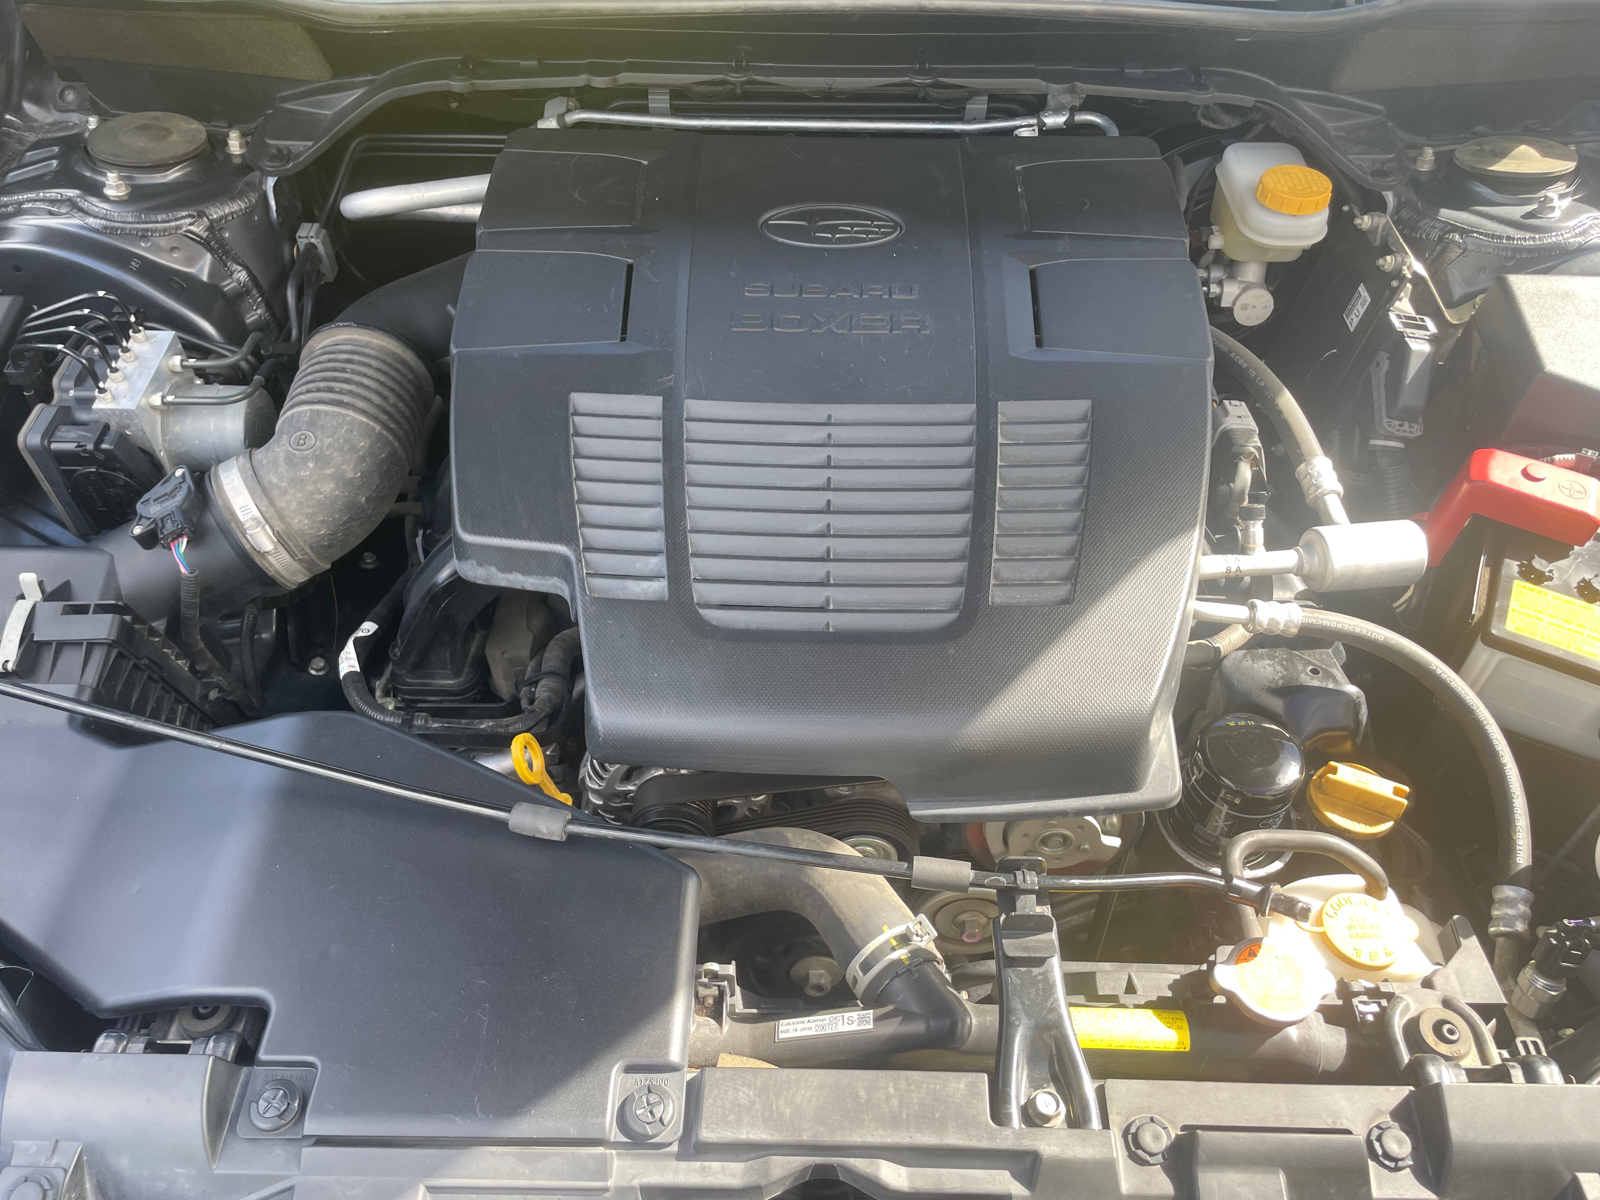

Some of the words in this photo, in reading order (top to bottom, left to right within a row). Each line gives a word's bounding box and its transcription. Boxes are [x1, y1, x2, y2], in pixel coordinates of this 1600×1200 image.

[744, 283, 918, 299] SUBARU
[730, 312, 932, 334] BOXER
[1255, 376, 1265, 387] LP
[296, 433, 308, 447] B
[1516, 582, 1549, 597] DANGER
[1511, 608, 1544, 622] POISON
